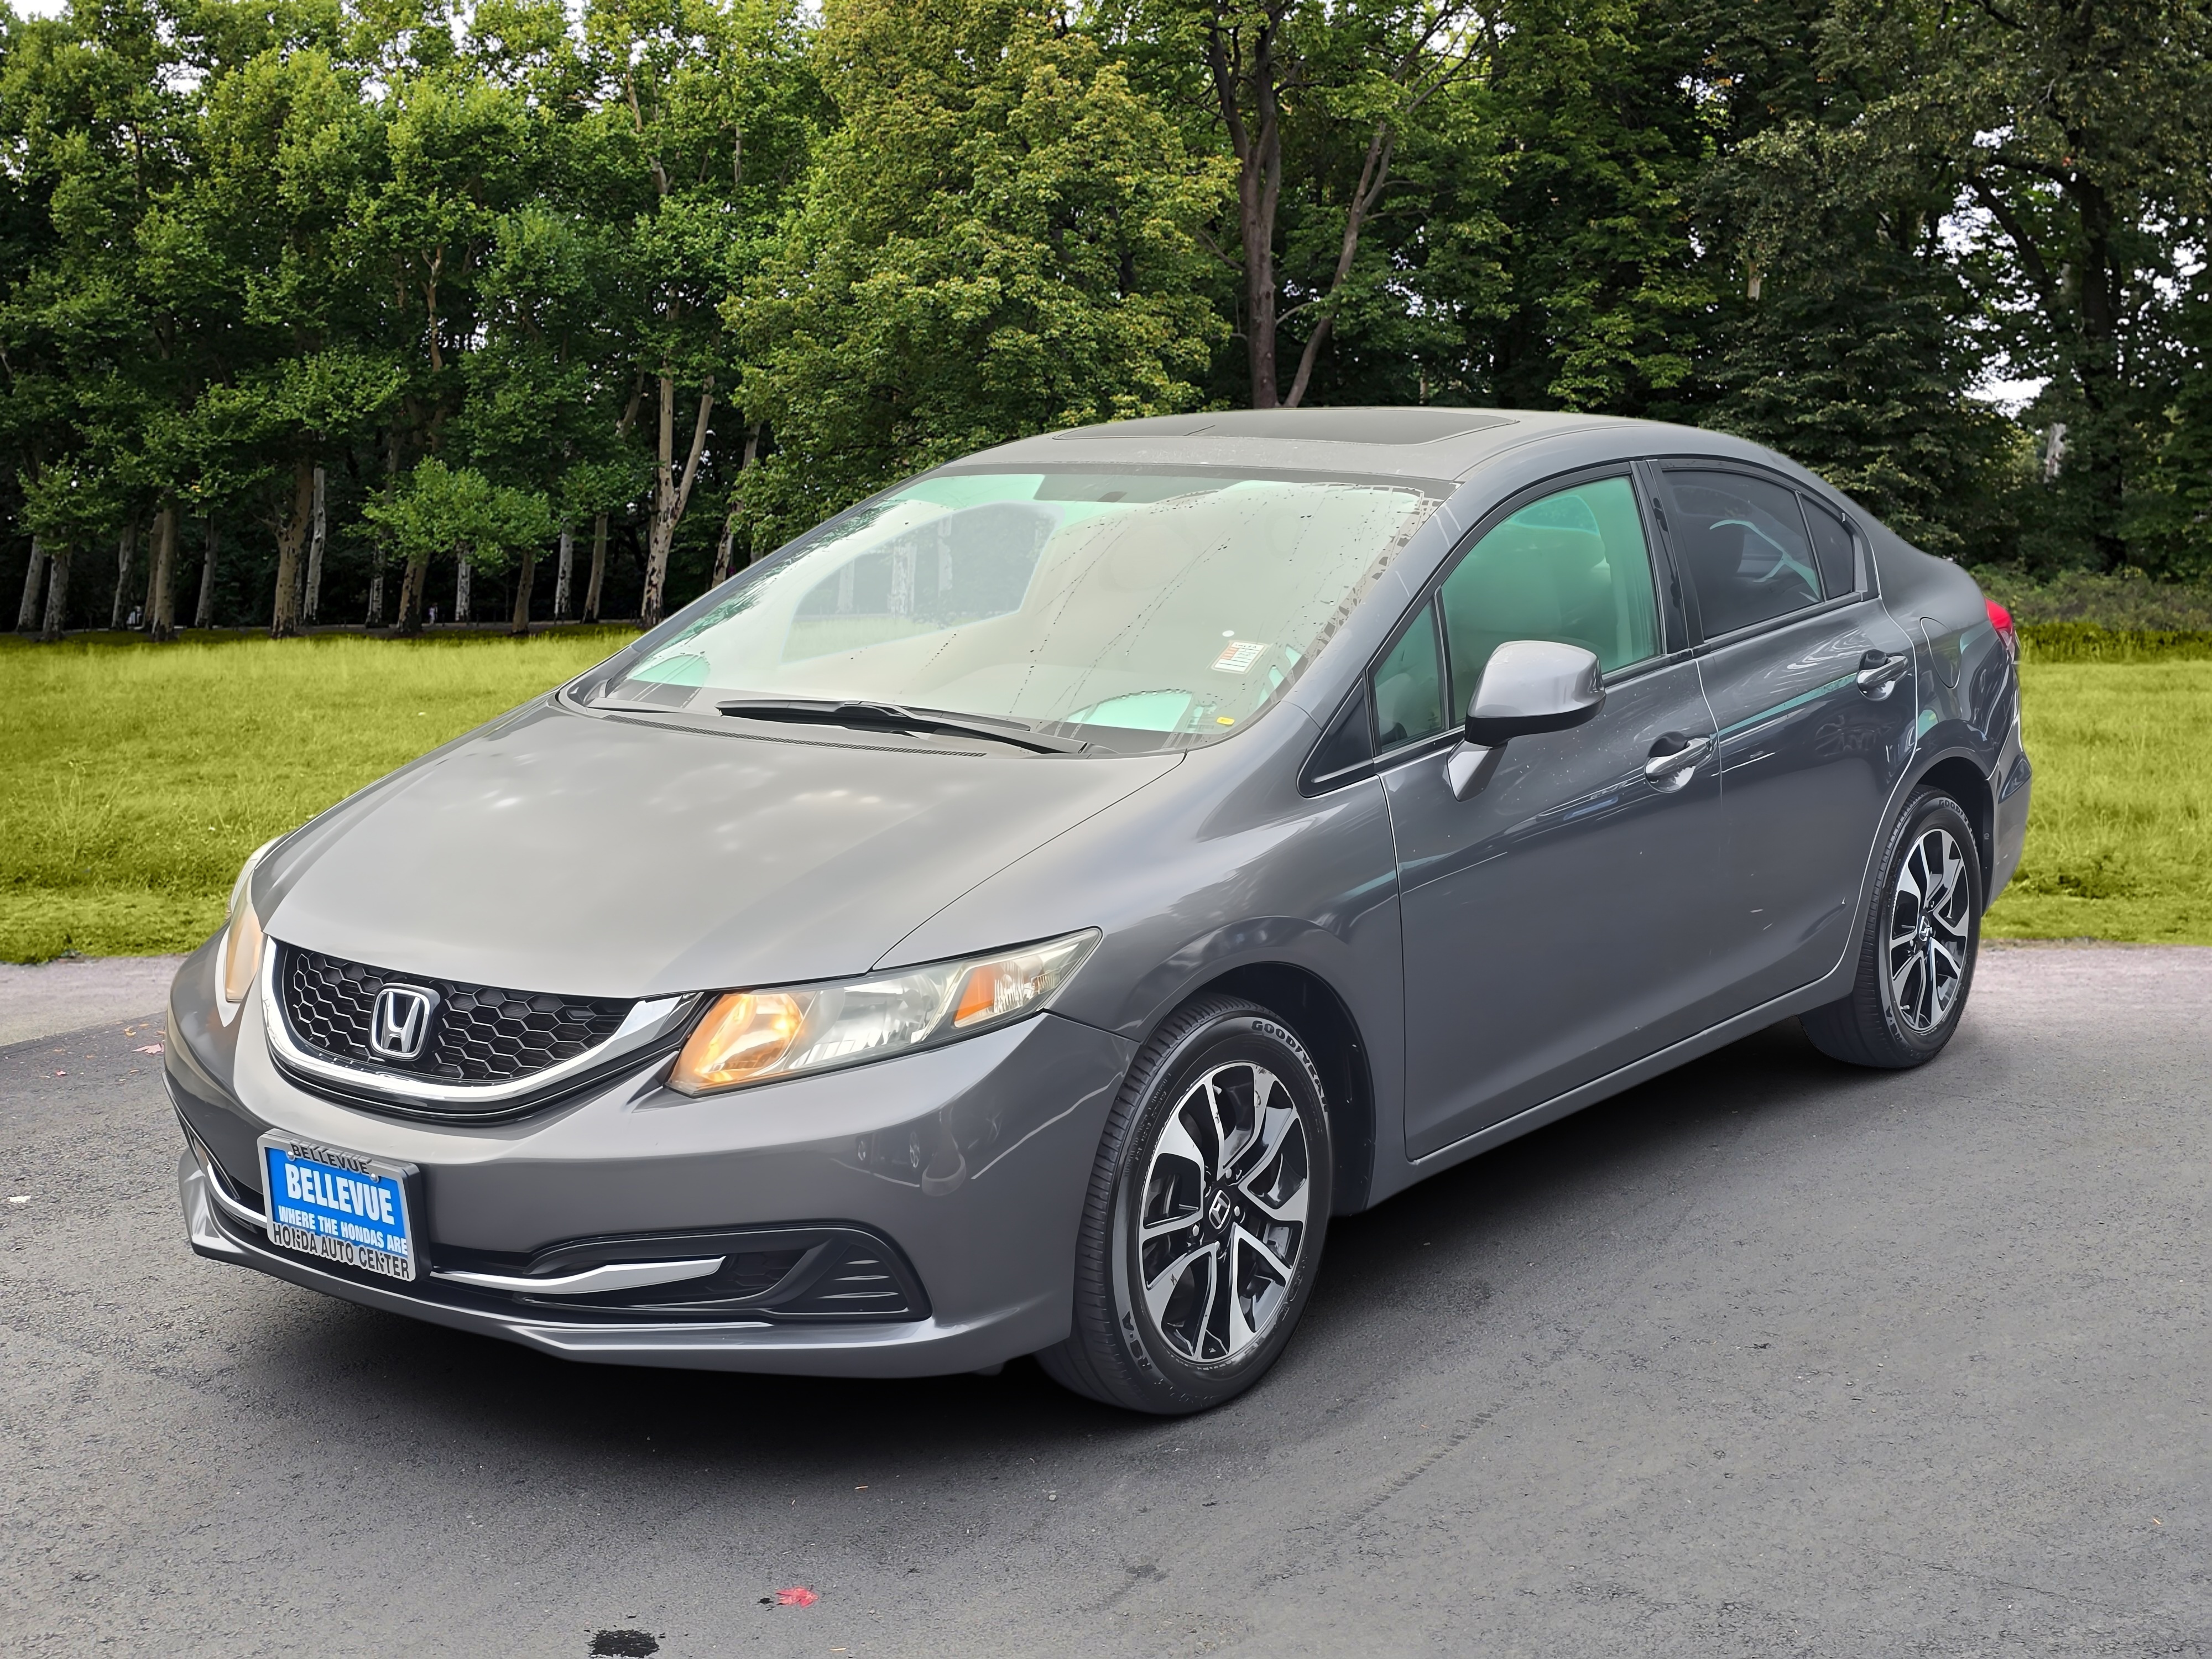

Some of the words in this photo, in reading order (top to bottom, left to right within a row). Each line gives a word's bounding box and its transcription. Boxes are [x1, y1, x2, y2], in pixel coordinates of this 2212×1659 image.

[290, 1143, 371, 1175] BELLEVUE
[285, 1163, 395, 1225] BELLEVUE
[273, 1223, 318, 1254] HONDA
[321, 1236, 354, 1264] AUTO
[358, 1246, 410, 1280] CENTER
[278, 1205, 316, 1230] WHERE
[317, 1215, 339, 1236] THE
[340, 1221, 384, 1249] HONDAS
[387, 1234, 408, 1255] ARE
